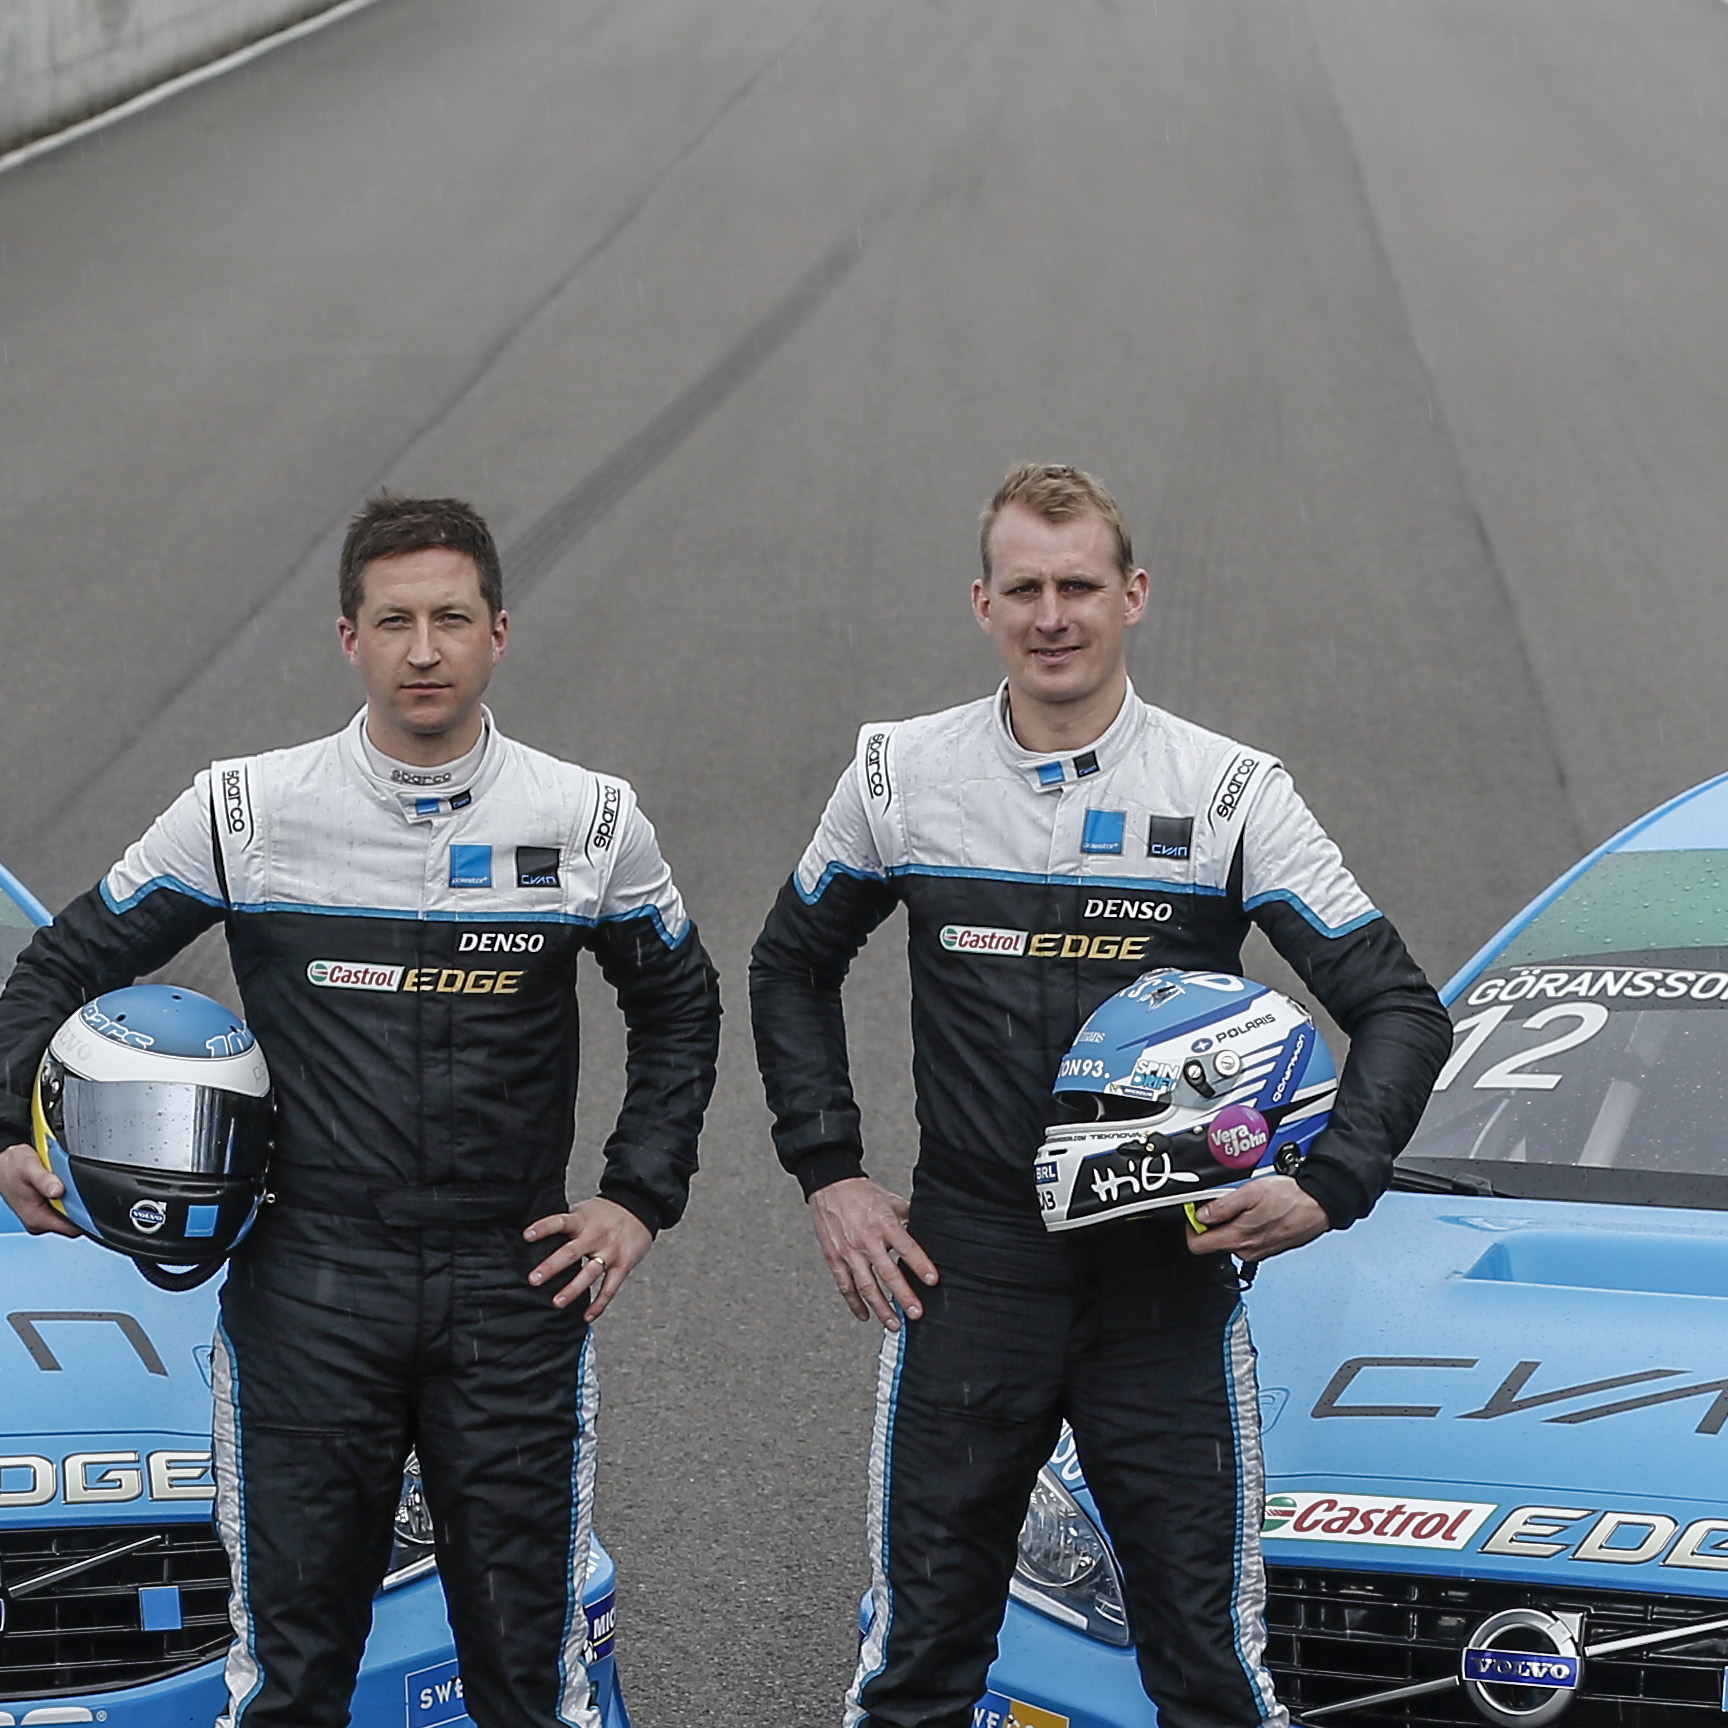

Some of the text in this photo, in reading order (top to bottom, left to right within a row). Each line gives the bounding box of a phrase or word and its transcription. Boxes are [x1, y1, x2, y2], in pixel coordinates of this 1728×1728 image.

[867, 733, 885, 797] sparco
[222, 769, 246, 833] sparco
[1216, 758, 1255, 818] sparco
[593, 785, 617, 850] sparco
[1083, 899, 1172, 922] DENSO
[458, 932, 545, 953] DENSO
[958, 929, 1152, 960] Castrol EDGE
[328, 965, 527, 994] Castrol EDGE
[1215, 1013, 1276, 1043] POLARIS
[1434, 1002, 1610, 1091] 12
[1135, 1060, 1181, 1080] SPIN
[1211, 1124, 1250, 1146] Vera
[1233, 1131, 1267, 1157] John
[1091, 1151, 1201, 1202] HiQ
[132, 1210, 164, 1221] VOLVO
[1291, 1498, 1476, 1542] Castrol
[1472, 1656, 1572, 1682] VOLVO
